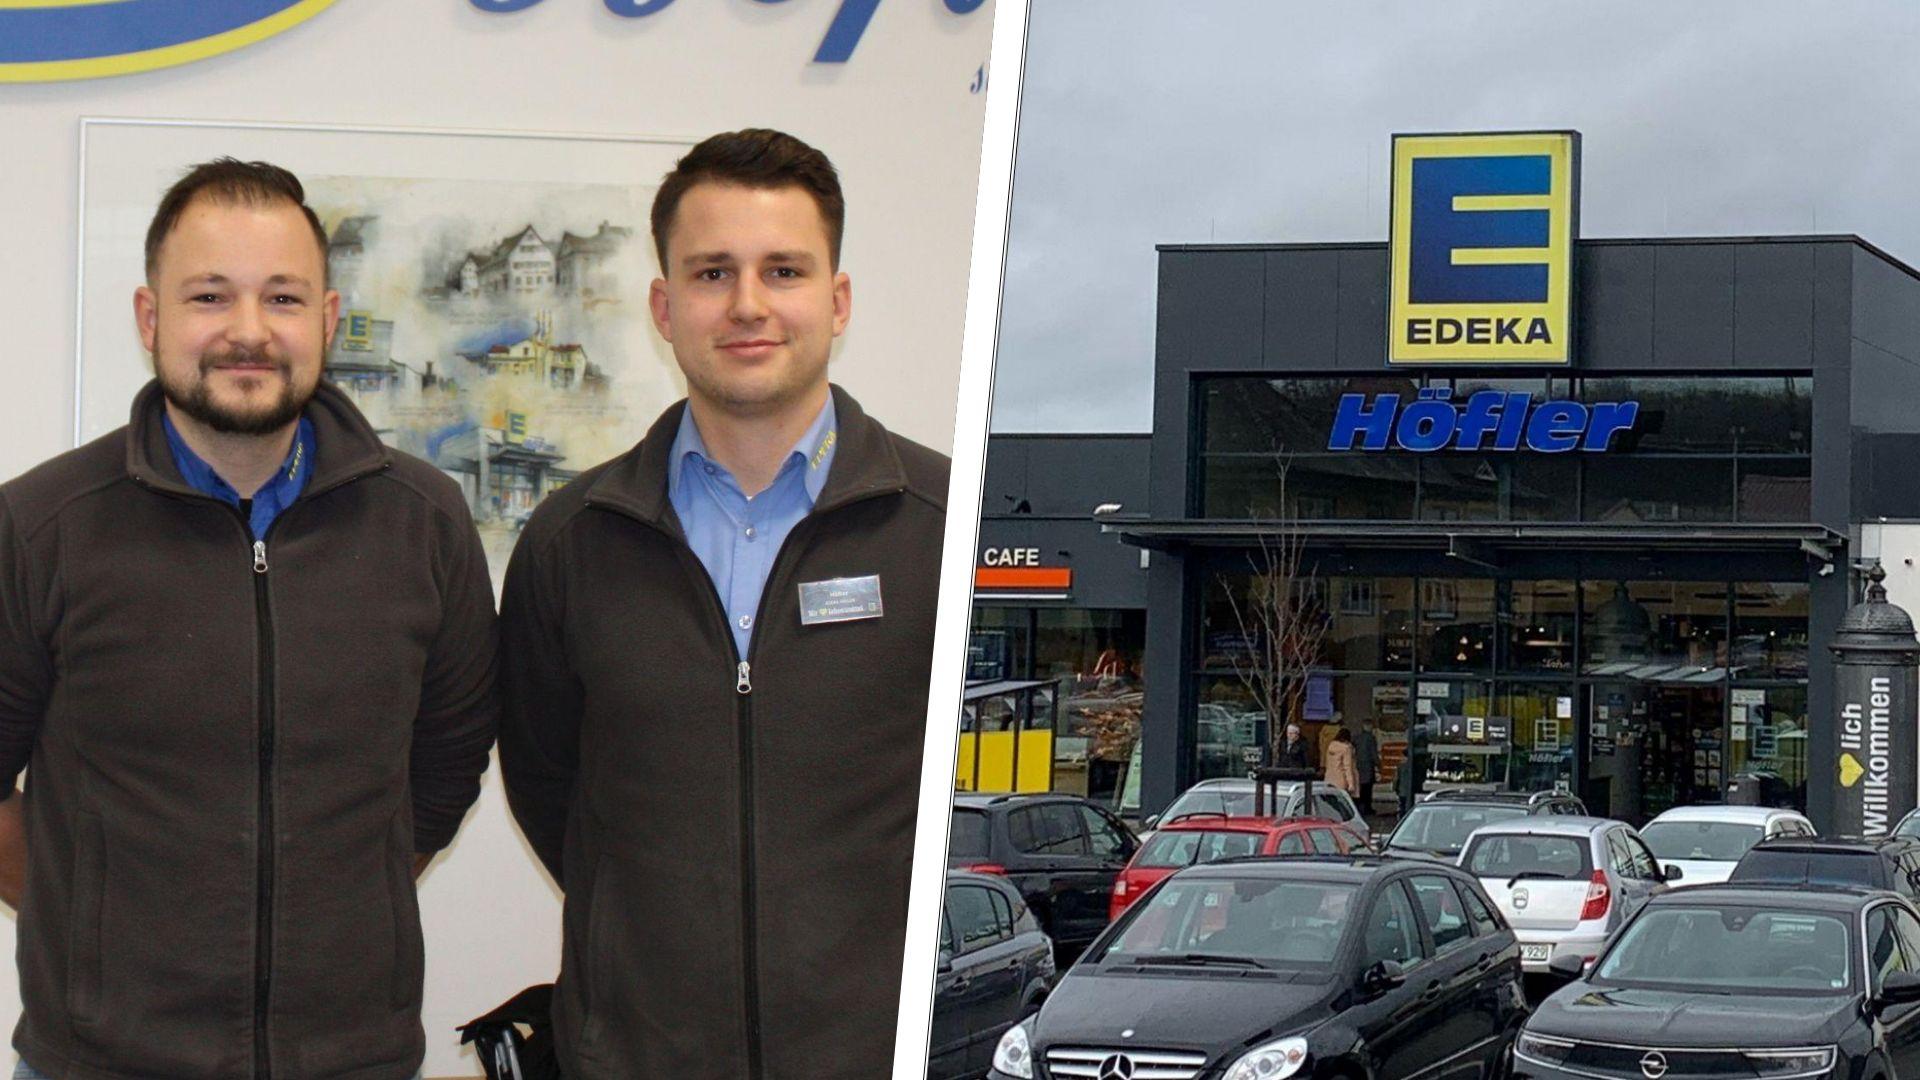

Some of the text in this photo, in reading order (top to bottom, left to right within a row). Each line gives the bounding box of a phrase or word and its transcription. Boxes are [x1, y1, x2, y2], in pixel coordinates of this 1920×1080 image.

[1407, 154, 1552, 305] E
[1406, 317, 1553, 345] EDEKA
[1328, 387, 1639, 452] Höfler
[983, 547, 1040, 566] CAFE
[1841, 703, 1862, 749] lich
[1863, 677, 1890, 836] Willkommen
